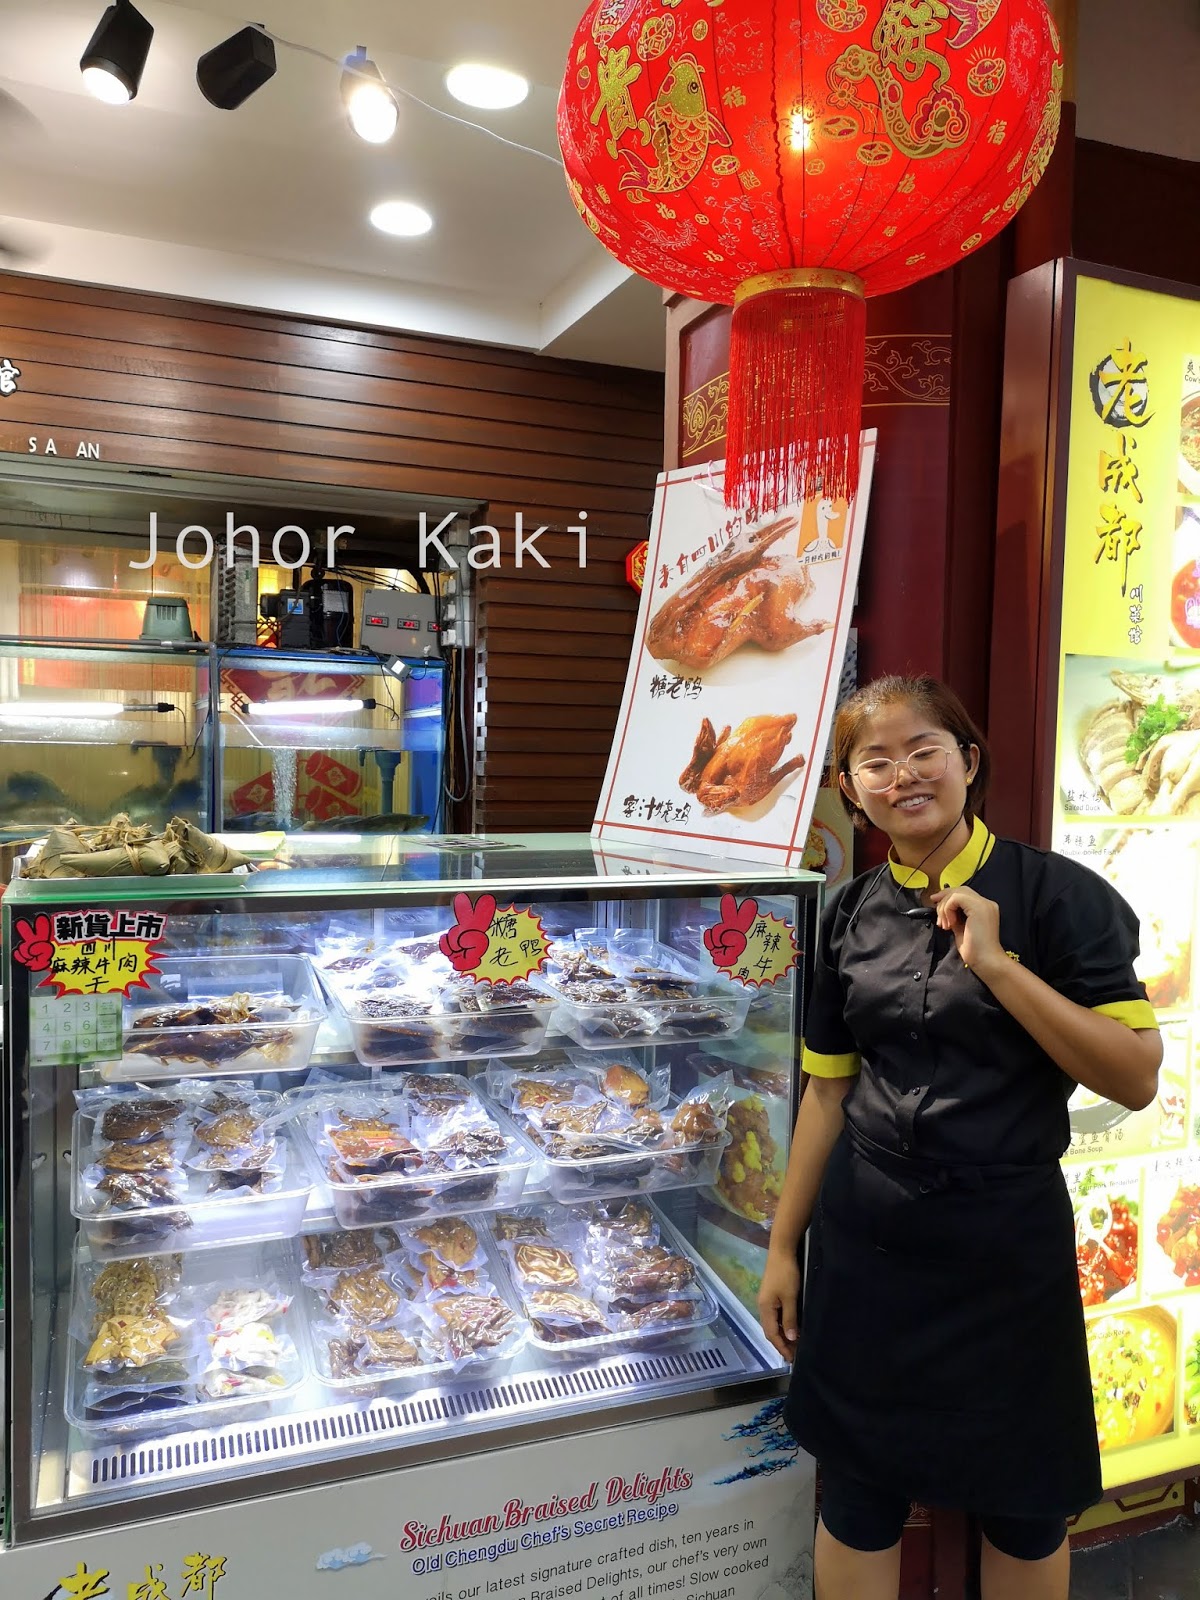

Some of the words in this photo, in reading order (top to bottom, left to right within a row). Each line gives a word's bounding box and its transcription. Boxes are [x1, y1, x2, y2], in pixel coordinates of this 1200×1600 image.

[1094, 336, 1157, 598] 老成都
[649, 673, 703, 700] 糖老鸭
[55, 912, 164, 941] 新貨上市
[50, 952, 138, 976] 麻辣牛肉
[42, 1003, 49, 1014] 1
[63, 1002, 71, 1013] 2
[82, 1001, 91, 1012] 3
[42, 1022, 51, 1033] 4
[63, 1021, 71, 1032] 5
[82, 1020, 91, 1031] 6
[43, 1040, 51, 1051] 7
[62, 1039, 72, 1050] 8
[82, 1038, 91, 1049] 9
[1086, 1146, 1104, 1154] Soup
[399, 1514, 502, 1553] Sichuan
[502, 1482, 601, 1530] Braised
[604, 1465, 694, 1507] Delights
[411, 1552, 443, 1576] Old
[444, 1537, 519, 1569] Chengdu
[520, 1525, 572, 1550] Chef's
[573, 1512, 625, 1537] Secret
[626, 1501, 679, 1525] Recipe
[458, 1585, 482, 1599] our
[486, 1572, 526, 1594] latest
[530, 1557, 593, 1583] signature
[596, 1540, 645, 1566] crafted
[648, 1535, 678, 1554] dish,
[681, 1532, 702, 1546] ten
[705, 1521, 740, 1543] years
[743, 1518, 755, 1530] in
[531, 1579, 583, 1600] Braised
[586, 1566, 643, 1591] Delights,
[647, 1560, 668, 1575] our
[671, 1549, 710, 1568] chef's
[713, 1544, 740, 1562] very
[742, 1536, 768, 1551] own
[628, 1586, 643, 1600] all
[647, 1575, 686, 1597] times!
[689, 1569, 720, 1586] Slow
[722, 1555, 770, 1577] cooked
